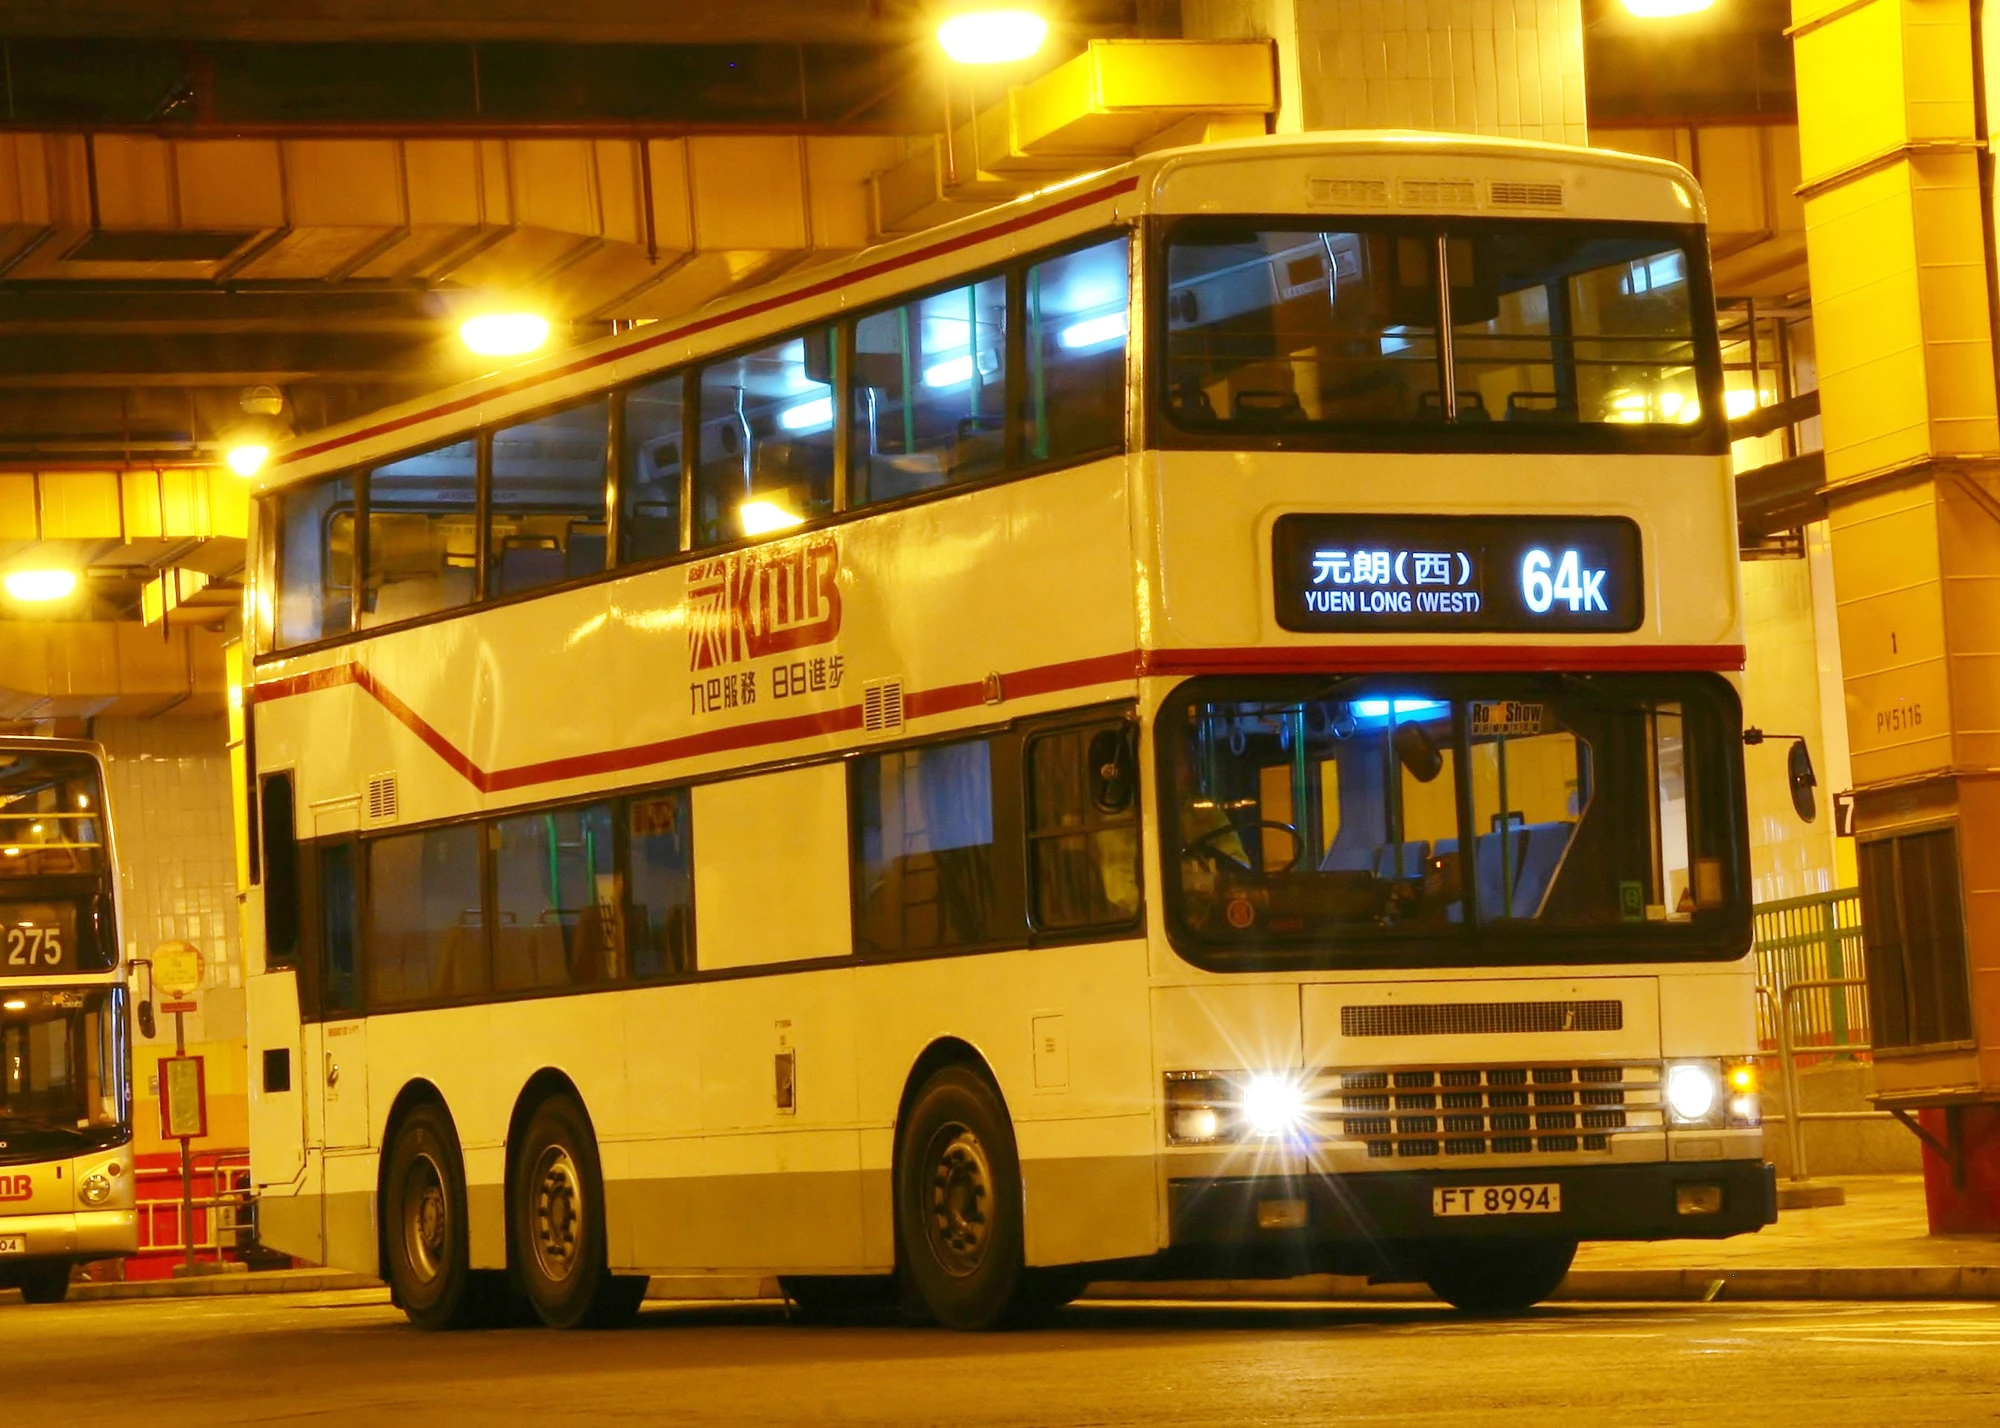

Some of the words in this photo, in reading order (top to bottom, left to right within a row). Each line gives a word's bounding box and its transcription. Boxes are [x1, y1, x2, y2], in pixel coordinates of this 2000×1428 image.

[1312, 550, 1471, 585] 元朗(西)
[1521, 549, 1609, 614] 64K
[1304, 591, 1356, 613] YUEN
[1359, 591, 1412, 612] LONG
[1415, 592, 1481, 613] (WEST)
[690, 670, 757, 716] 九巴服務
[772, 655, 844, 699] 日日進步
[1838, 796, 1854, 834] 7
[7, 928, 62, 966] 275
[1441, 1189, 1475, 1213] FT
[1484, 1186, 1550, 1212] 8994
